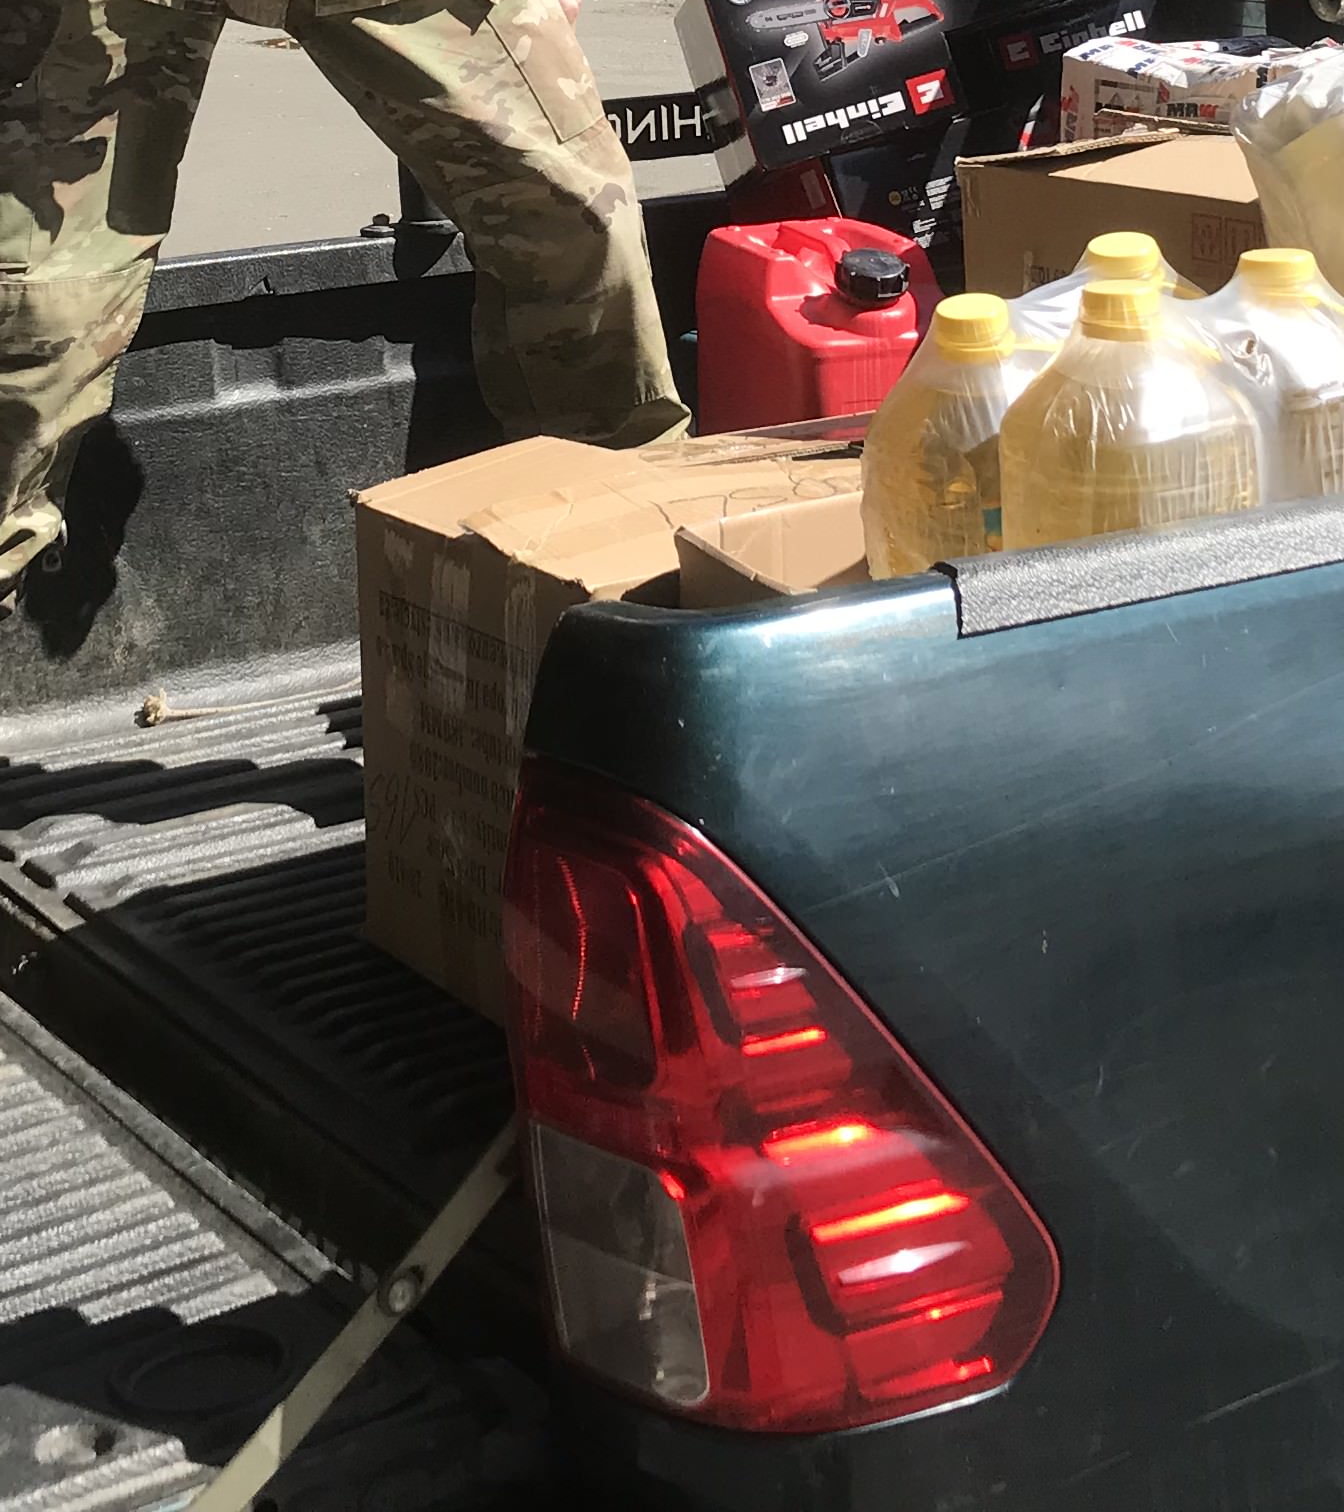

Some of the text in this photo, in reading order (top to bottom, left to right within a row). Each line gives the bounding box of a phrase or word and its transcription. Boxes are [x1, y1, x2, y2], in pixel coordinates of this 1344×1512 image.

[1039, 9, 1147, 55] Einhell
[782, 90, 907, 145] Einhell
[1166, 102, 1219, 119] MRW
